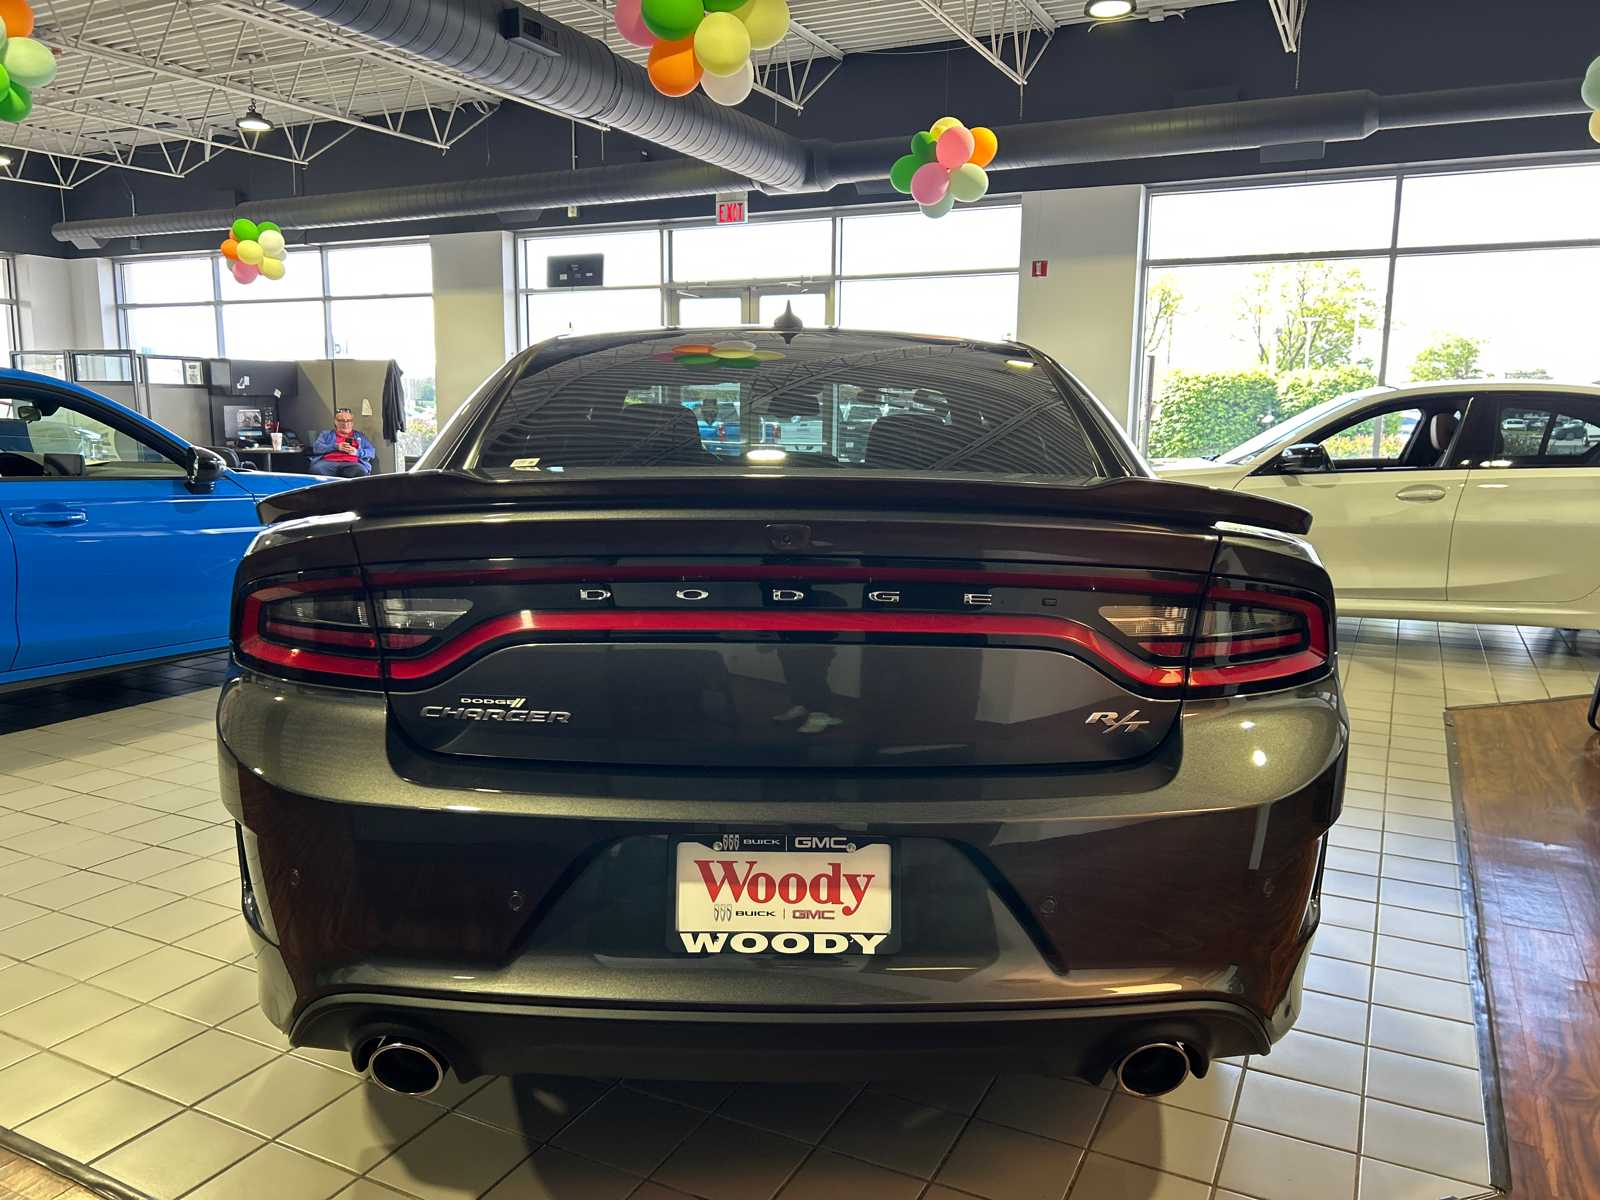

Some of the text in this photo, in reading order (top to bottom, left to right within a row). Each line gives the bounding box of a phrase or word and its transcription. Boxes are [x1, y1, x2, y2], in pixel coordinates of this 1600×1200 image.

[719, 203, 743, 222] EXIT
[580, 589, 992, 606] DODGE
[460, 697, 516, 705] DODGE
[419, 705, 572, 724] CHARGER
[1085, 709, 1150, 734] R/T
[794, 836, 848, 849] GMC
[693, 860, 876, 916] Woody
[792, 909, 835, 920] GMC
[679, 932, 888, 955] WOODY
